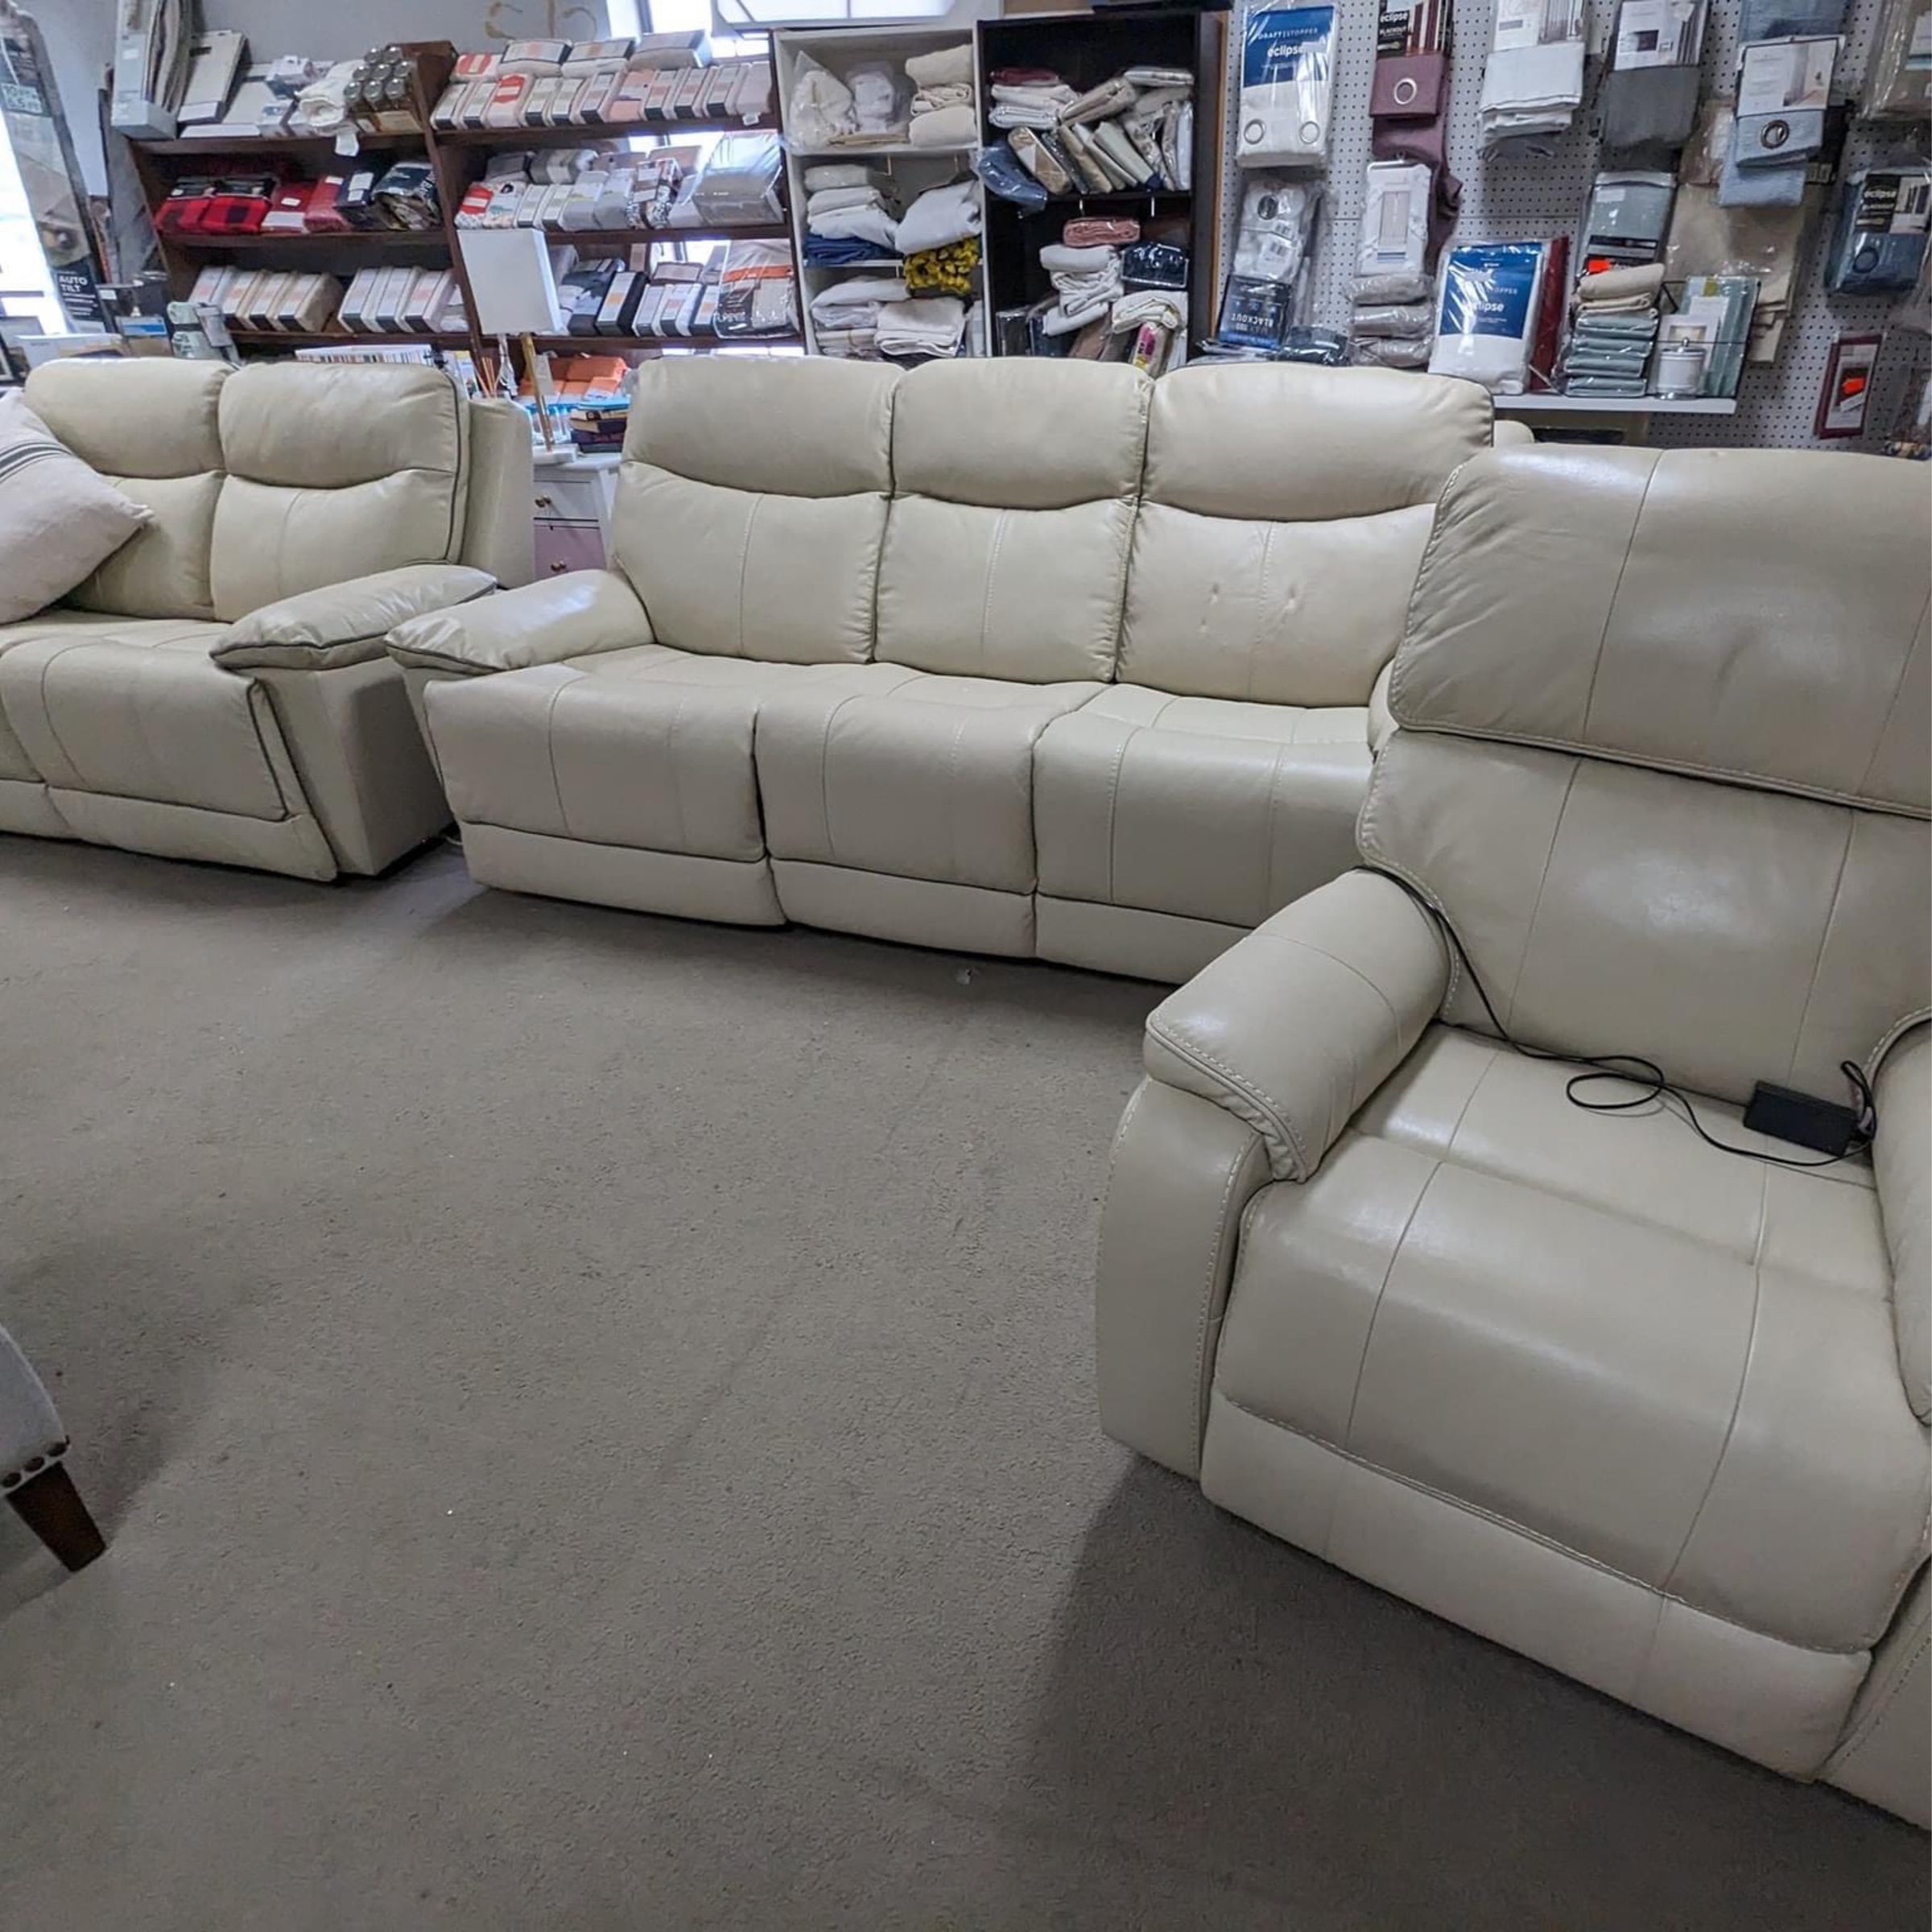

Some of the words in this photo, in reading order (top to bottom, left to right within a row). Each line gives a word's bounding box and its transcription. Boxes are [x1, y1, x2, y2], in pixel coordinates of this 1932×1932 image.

[1380, 12, 1408, 23] eclipse
[59, 275, 88, 286] AUTO
[1230, 312, 1274, 328] BLACKOUT
